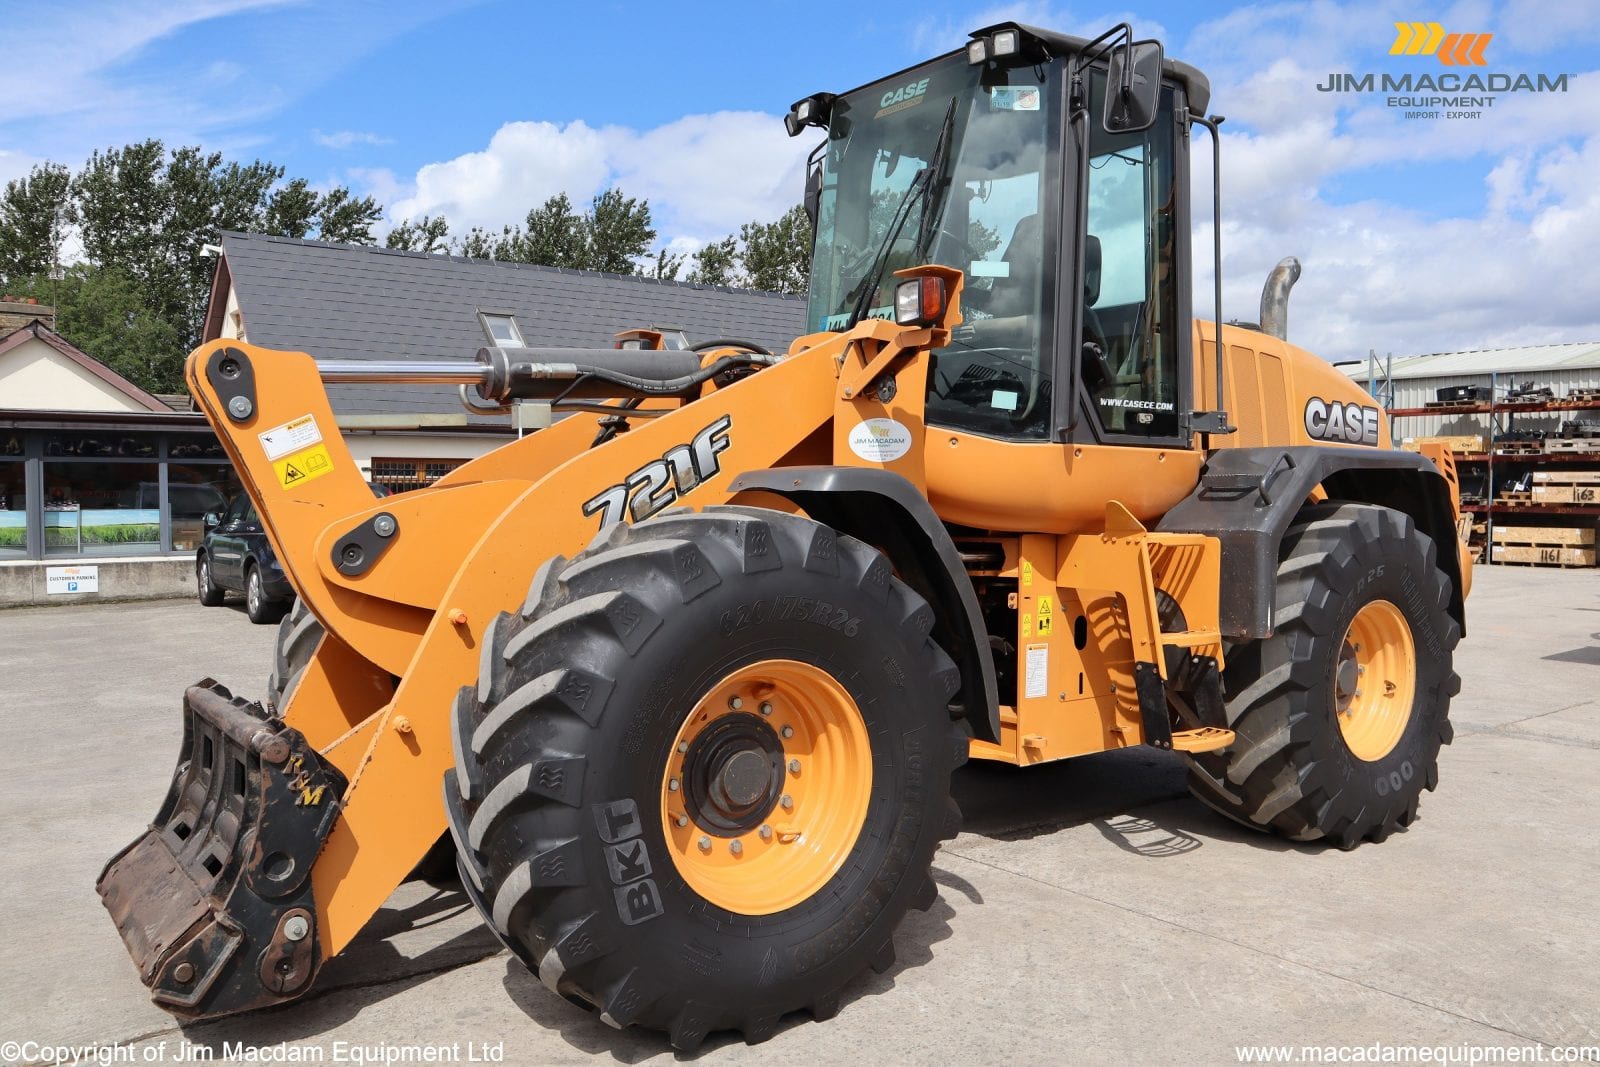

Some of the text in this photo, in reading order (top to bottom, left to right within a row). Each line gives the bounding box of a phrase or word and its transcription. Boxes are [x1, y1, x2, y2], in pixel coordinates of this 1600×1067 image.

[880, 77, 930, 108] CASE
[1100, 397, 1173, 411] WWW.CASECE.COM
[1304, 397, 1379, 446] CASE
[581, 413, 732, 531] 721F
[593, 798, 664, 926] BKT
